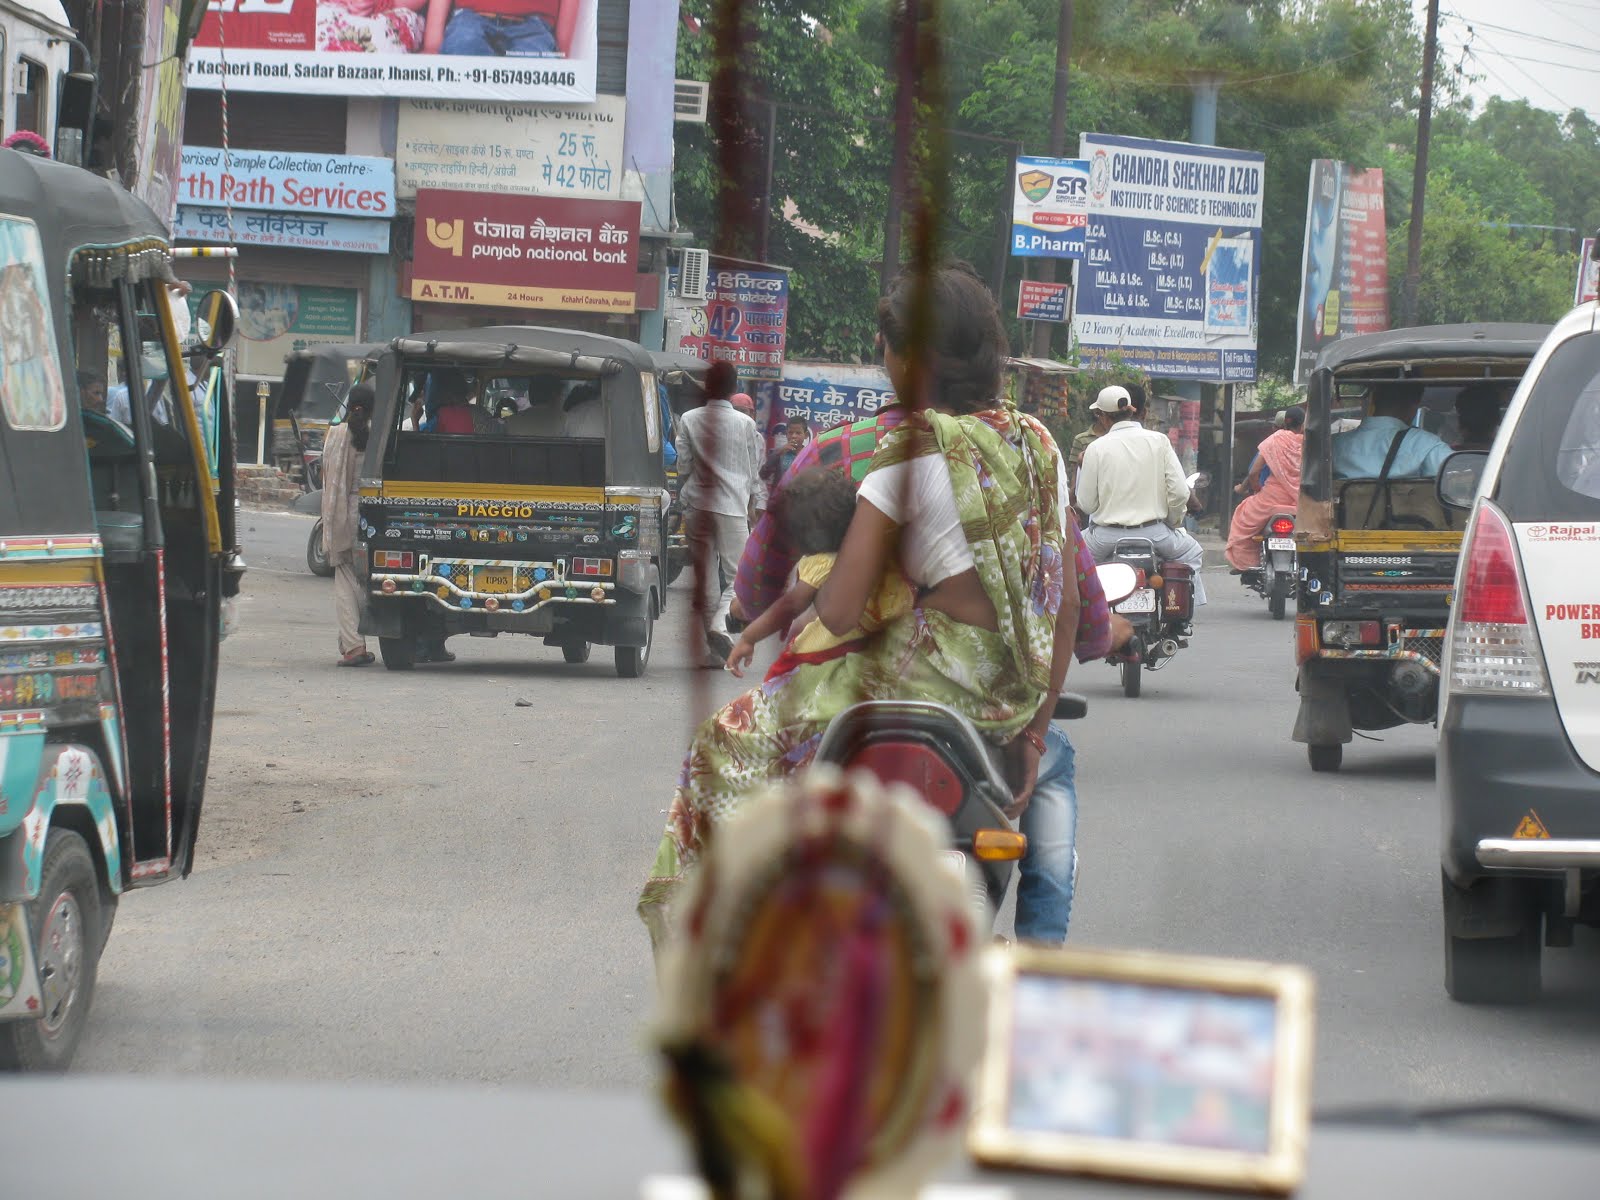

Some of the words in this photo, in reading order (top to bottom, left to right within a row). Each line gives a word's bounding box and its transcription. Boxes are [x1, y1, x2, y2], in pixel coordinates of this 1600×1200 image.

[197, 60, 250, 75] Kacheri
[253, 62, 291, 78] Road,
[294, 63, 334, 78] Sadar
[337, 65, 385, 81] Bazaar,
[388, 67, 434, 82] Jhansi,
[437, 68, 461, 83] Ph.:
[463, 69, 576, 86] +91-8574934446
[489, 145, 502, 158] 15
[559, 132, 577, 156] 25
[225, 154, 267, 174] Sample
[268, 156, 322, 173] Collection
[556, 165, 576, 188] 42
[579, 159, 612, 192] फोटो
[1112, 153, 1169, 187] CHANDRA
[1172, 160, 1227, 193] SHEKHAR
[1228, 166, 1259, 196] AZAD
[219, 173, 275, 204] Path
[282, 177, 387, 213] Services
[1056, 176, 1087, 196] SR
[1110, 189, 1152, 211] INSTITUTE
[1153, 193, 1164, 211] OF
[1166, 195, 1199, 215] SCIENCE
[1200, 200, 1206, 216] &
[1208, 199, 1258, 219] TECHNOLOGY
[473, 217, 525, 240] पंजाब
[1066, 215, 1086, 226] 145
[1015, 234, 1084, 252] B.Pharm
[1145, 230, 1163, 243] B.Sc.
[1164, 231, 1182, 246] (C.S.)
[472, 244, 522, 260] punjab
[526, 245, 588, 262] national
[592, 248, 628, 264] bank
[1090, 249, 1112, 262] B.B.A.
[1150, 252, 1169, 265] B.Sc.
[717, 272, 783, 291] डिजिटल
[1120, 273, 1126, 284] &
[1158, 274, 1177, 287] M.Sc.
[420, 284, 475, 300] A.T.M.
[508, 292, 518, 301] 24
[519, 292, 544, 302] Hours
[1127, 294, 1133, 307] &
[1166, 295, 1184, 309] M.Sc.
[709, 305, 742, 343] 42
[1081, 321, 1090, 333] 12
[1092, 322, 1113, 335] Years
[1114, 323, 1124, 337] of
[1126, 325, 1162, 338] Academic
[1163, 325, 1204, 339] Excellence
[702, 341, 710, 360] 5
[1224, 352, 1233, 363] Toll
[1234, 353, 1243, 363] Free
[457, 506, 532, 518] PIAGGIO
[1549, 525, 1595, 536] Rajpal
[1546, 604, 1600, 620] POWER
